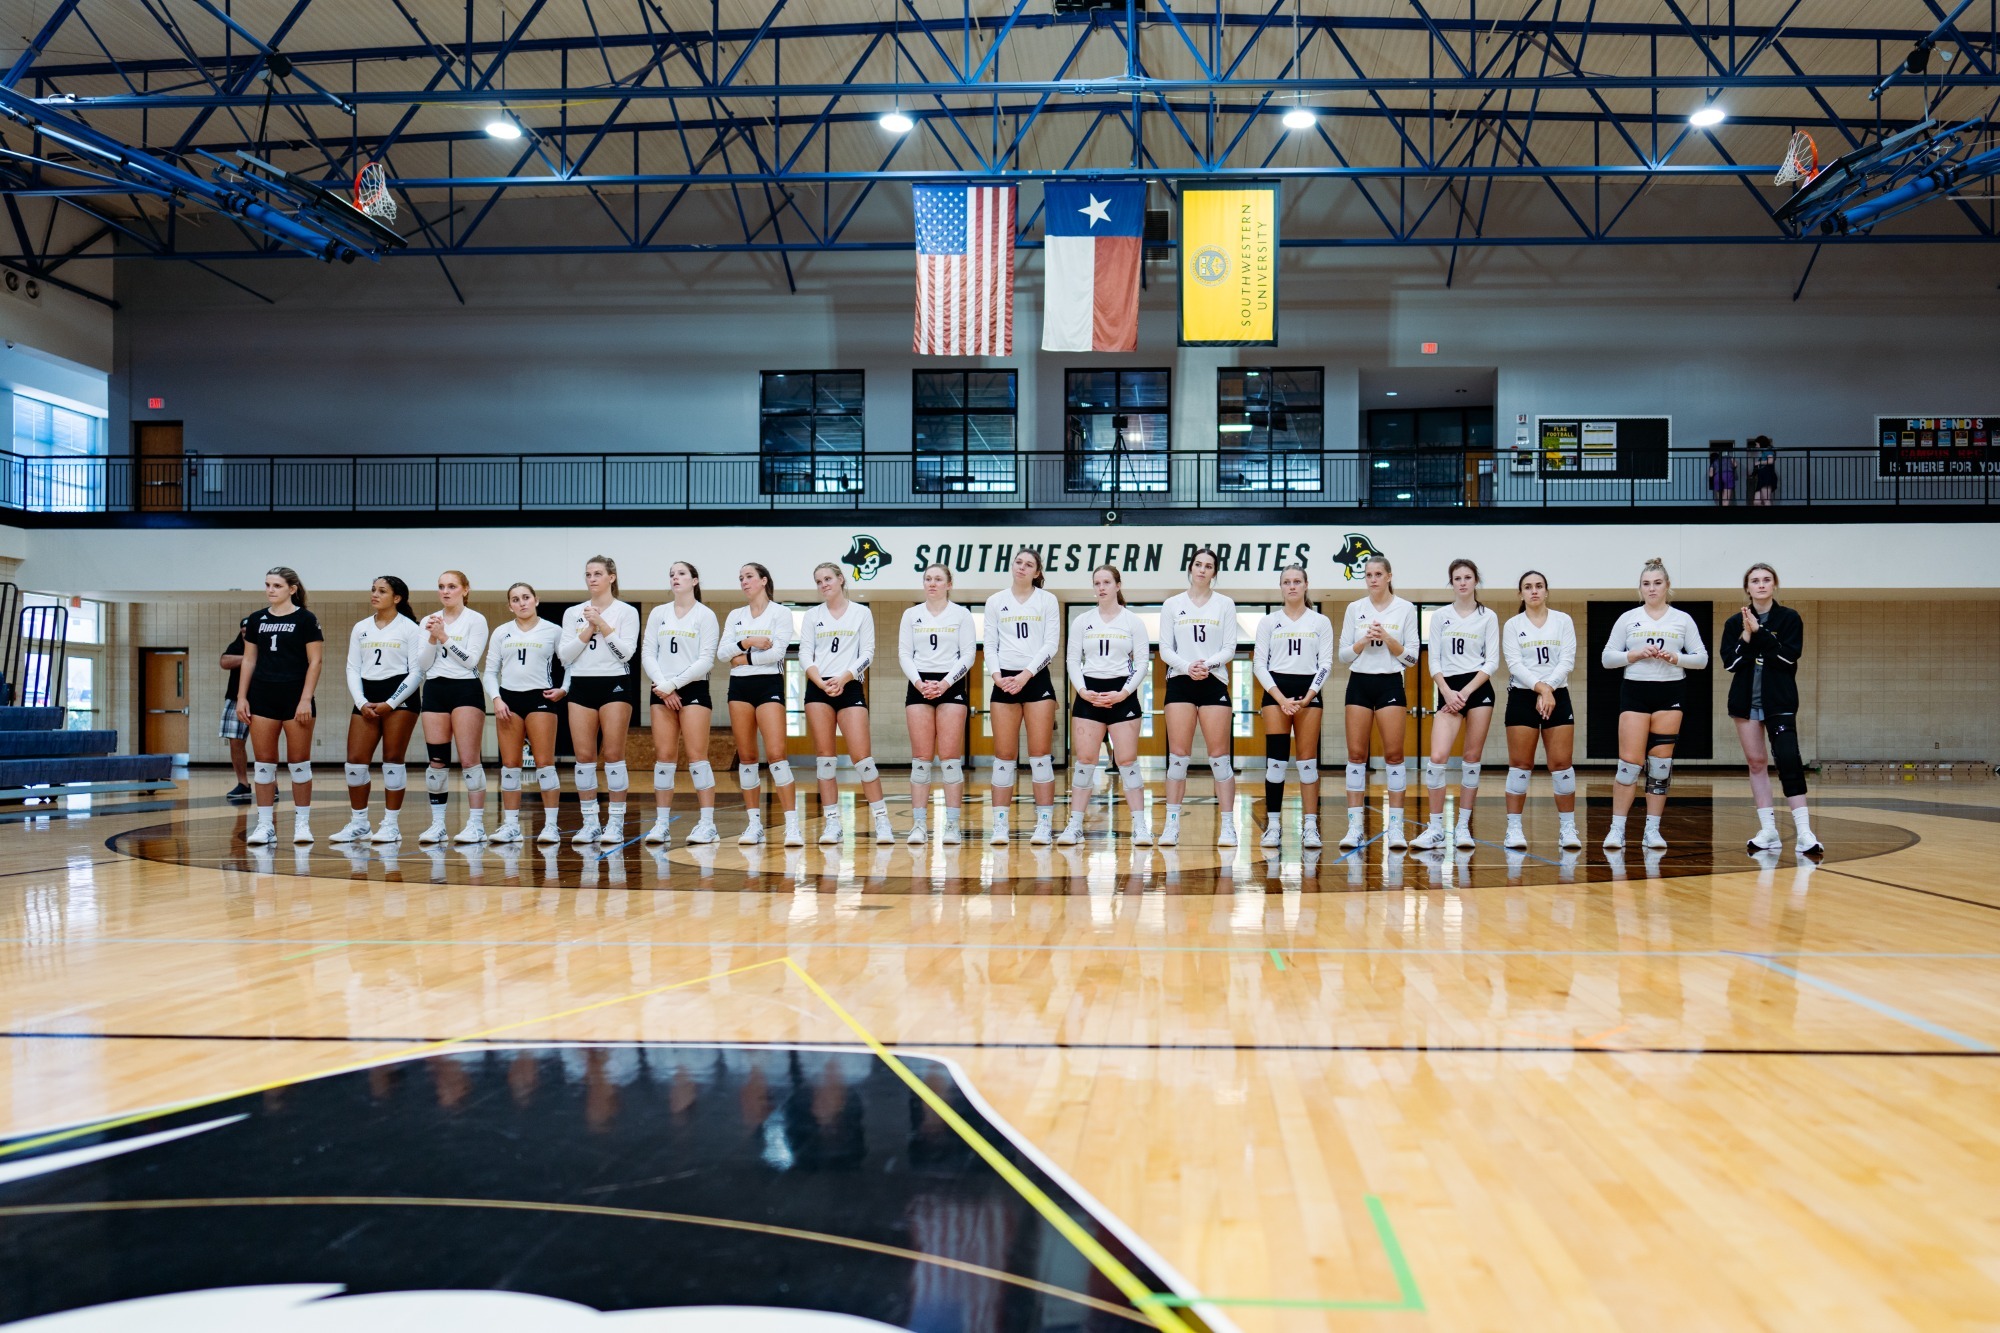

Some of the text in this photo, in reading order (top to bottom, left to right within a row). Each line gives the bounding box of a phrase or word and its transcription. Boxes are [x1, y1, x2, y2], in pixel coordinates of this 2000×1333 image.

[1241, 204, 1251, 327] SOUTHWESTERN
[1257, 221, 1268, 310] UNIVERSITY
[1906, 419, 1984, 431] FRIENDS
[1901, 449, 1950, 458] CAMPUS
[1905, 461, 1945, 473] THERE
[1949, 461, 1972, 473] FOR
[913, 543, 1311, 573] SOUTHESTERN PRATES
[258, 622, 296, 634] PIRATES
[1016, 622, 1029, 639] 10
[1193, 624, 1206, 643] 13
[270, 634, 278, 652] 1
[589, 633, 597, 650] 5
[670, 636, 678, 654] 6
[831, 636, 840, 653] 8
[929, 633, 938, 651] 9
[1099, 639, 1110, 656] 11
[1288, 638, 1301, 656] 14
[1451, 637, 1465, 655] 18
[374, 648, 382, 665] 2
[449, 644, 469, 662] PIRATES
[518, 648, 527, 665] 4
[1536, 646, 1550, 664] 19
